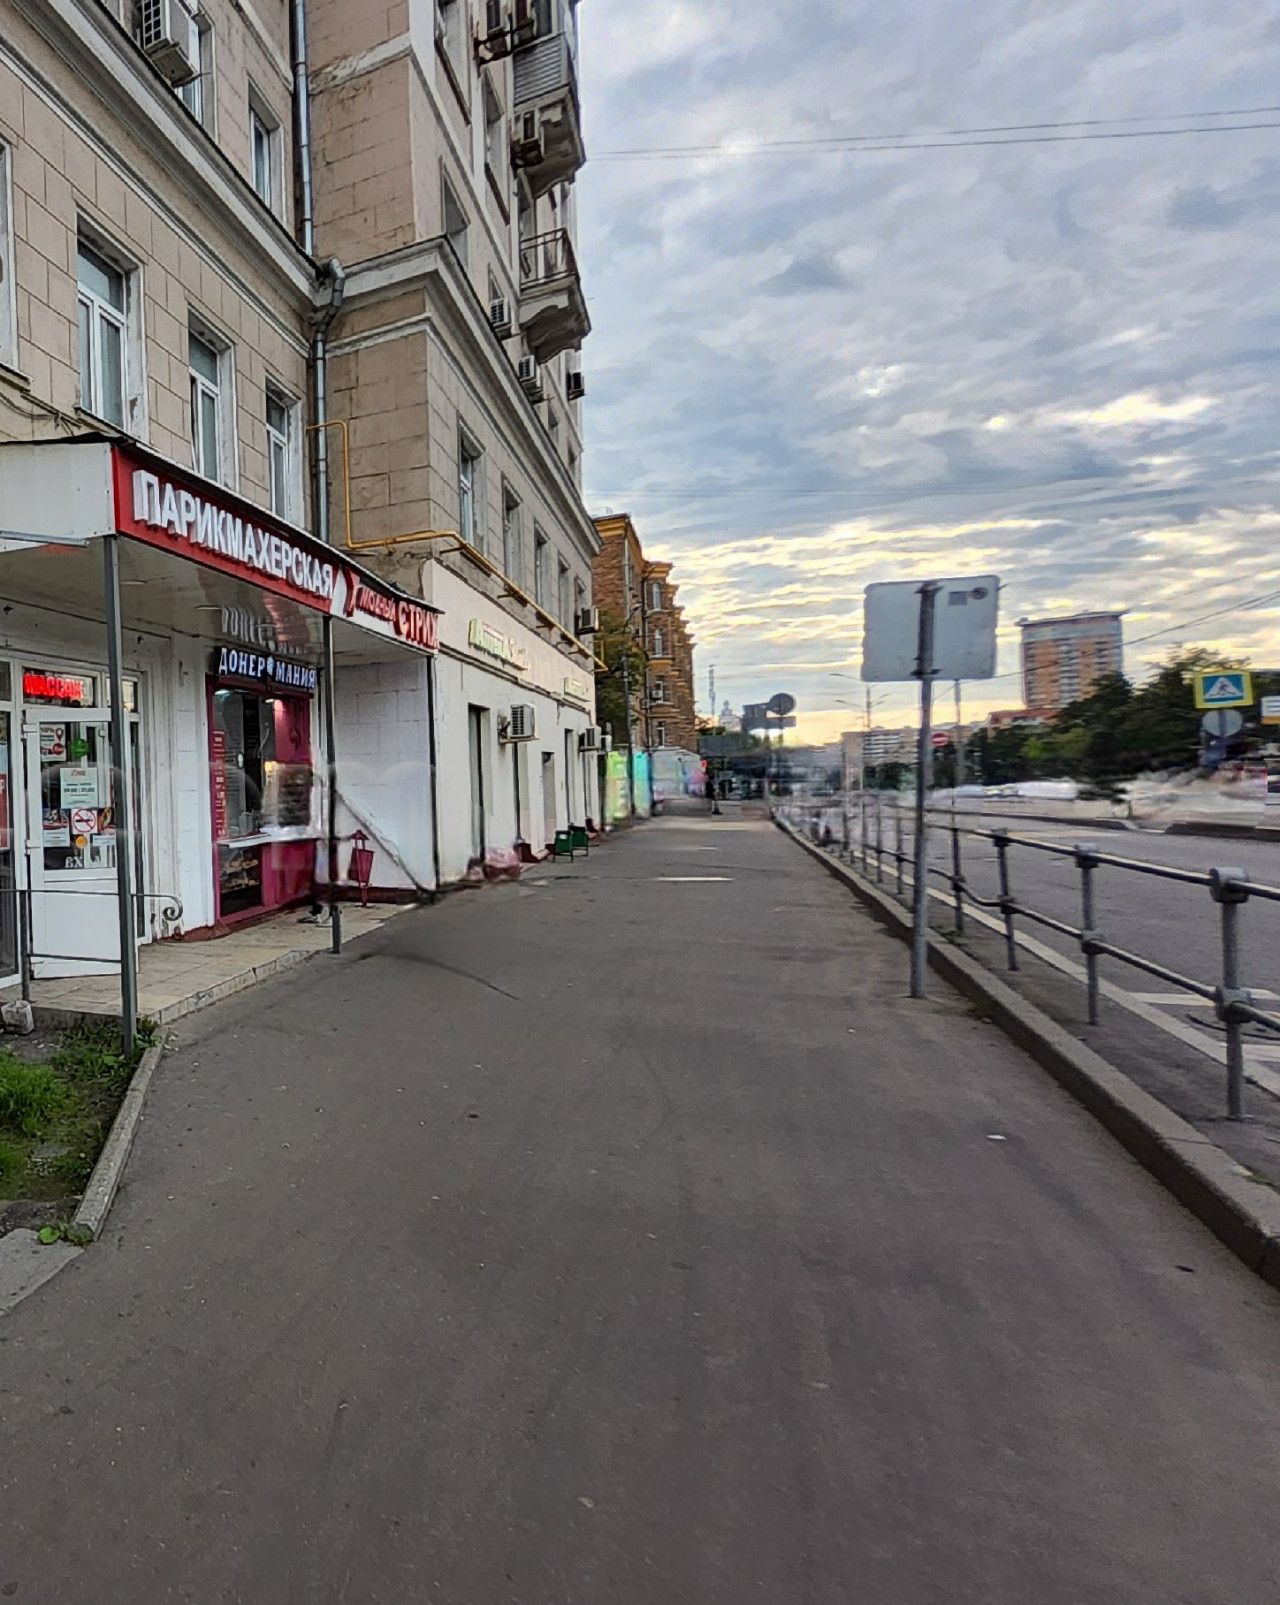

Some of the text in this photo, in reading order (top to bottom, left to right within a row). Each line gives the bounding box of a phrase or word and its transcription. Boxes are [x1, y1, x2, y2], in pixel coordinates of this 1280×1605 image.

[131, 469, 334, 600] ПАРИКМАХЕРСКАЯ
[219, 647, 318, 689] ДОНЕР МАНИЯ
